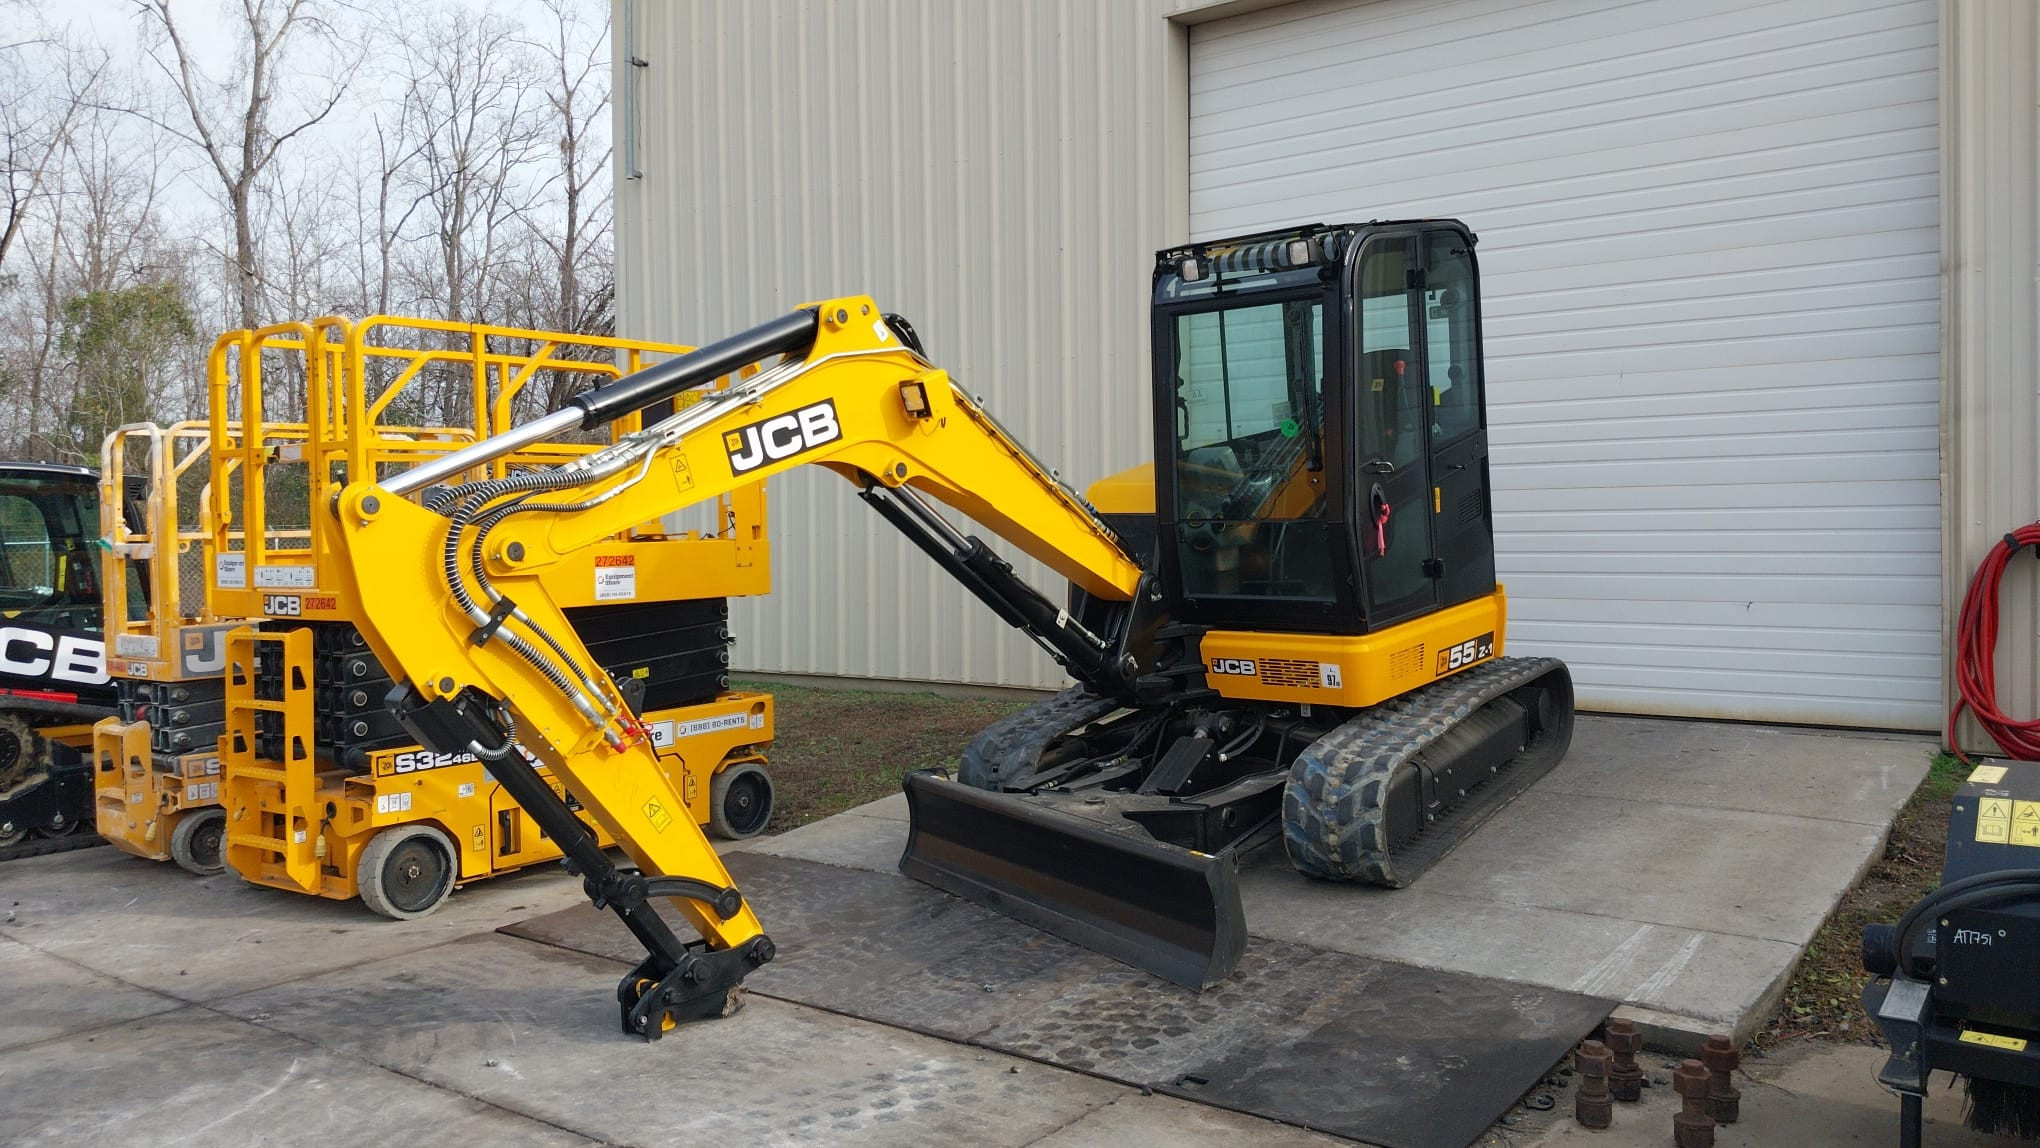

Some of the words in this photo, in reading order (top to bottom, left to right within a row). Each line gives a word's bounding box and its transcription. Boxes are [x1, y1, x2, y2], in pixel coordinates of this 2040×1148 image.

[731, 403, 838, 471] JCB
[595, 555, 634, 567] 272642
[265, 596, 300, 615] JCB
[305, 597, 336, 610] 272642
[1449, 640, 1475, 669] 55
[128, 663, 147, 676] JCB
[1213, 659, 1256, 675] JCB
[711, 716, 745, 729] 80-RENTS
